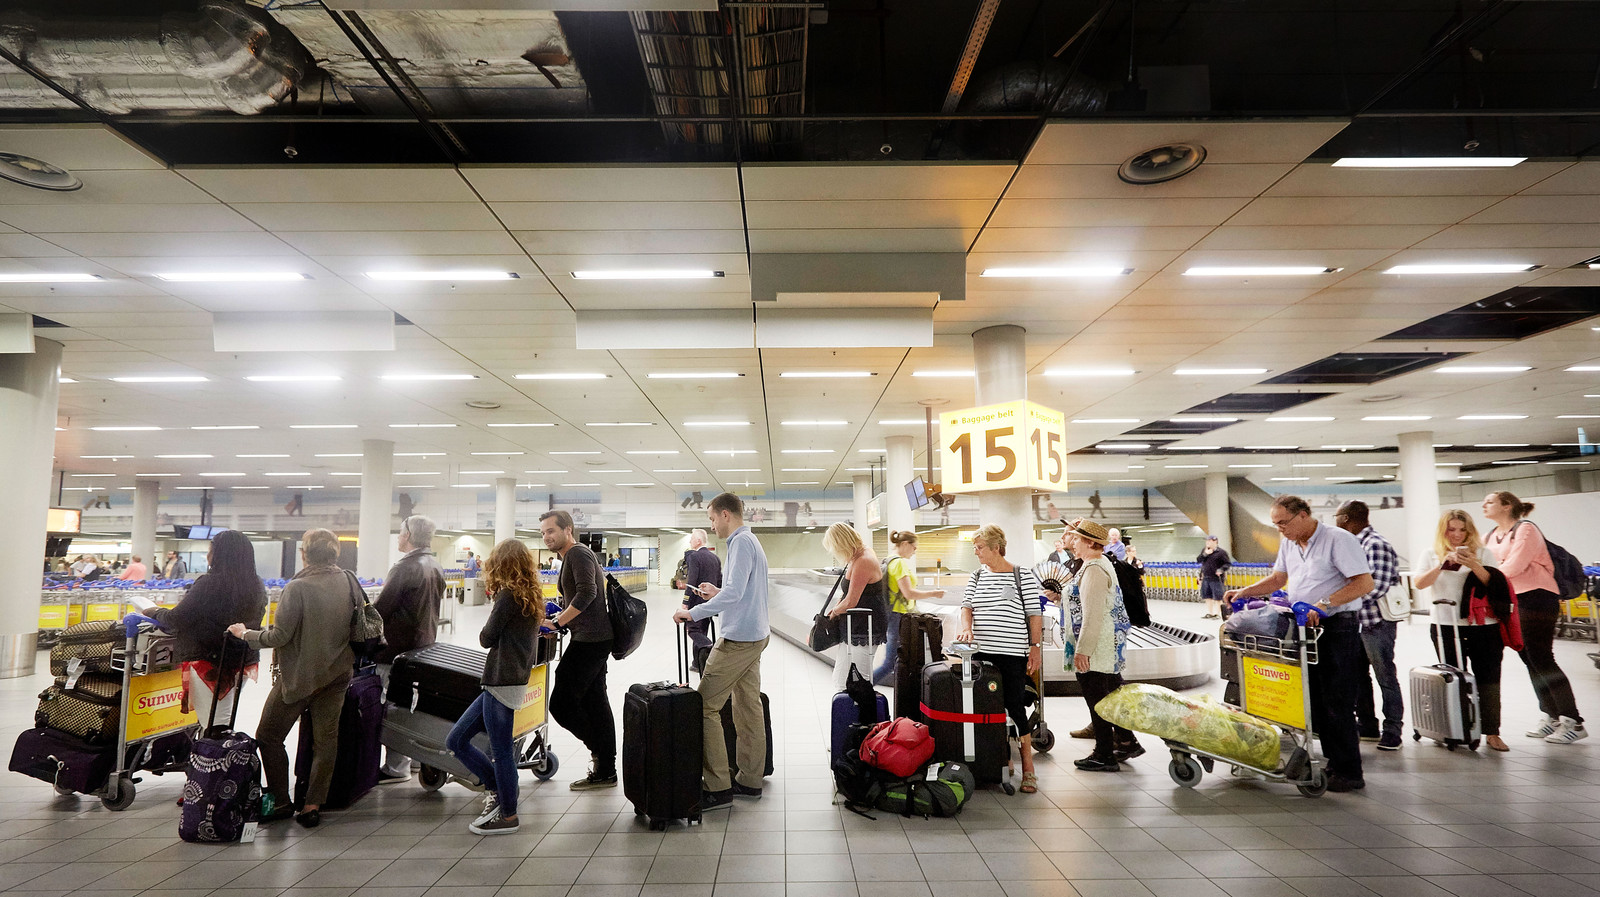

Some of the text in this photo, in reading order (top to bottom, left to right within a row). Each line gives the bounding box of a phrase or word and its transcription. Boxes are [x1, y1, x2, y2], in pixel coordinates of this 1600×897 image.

[961, 409, 1014, 425] Baggage belt
[949, 426, 1017, 484] 15
[1030, 427, 1063, 484] 15
[1253, 664, 1291, 681] Sunweb
[138, 690, 184, 709] Sunwe
[523, 686, 542, 704] nweb
